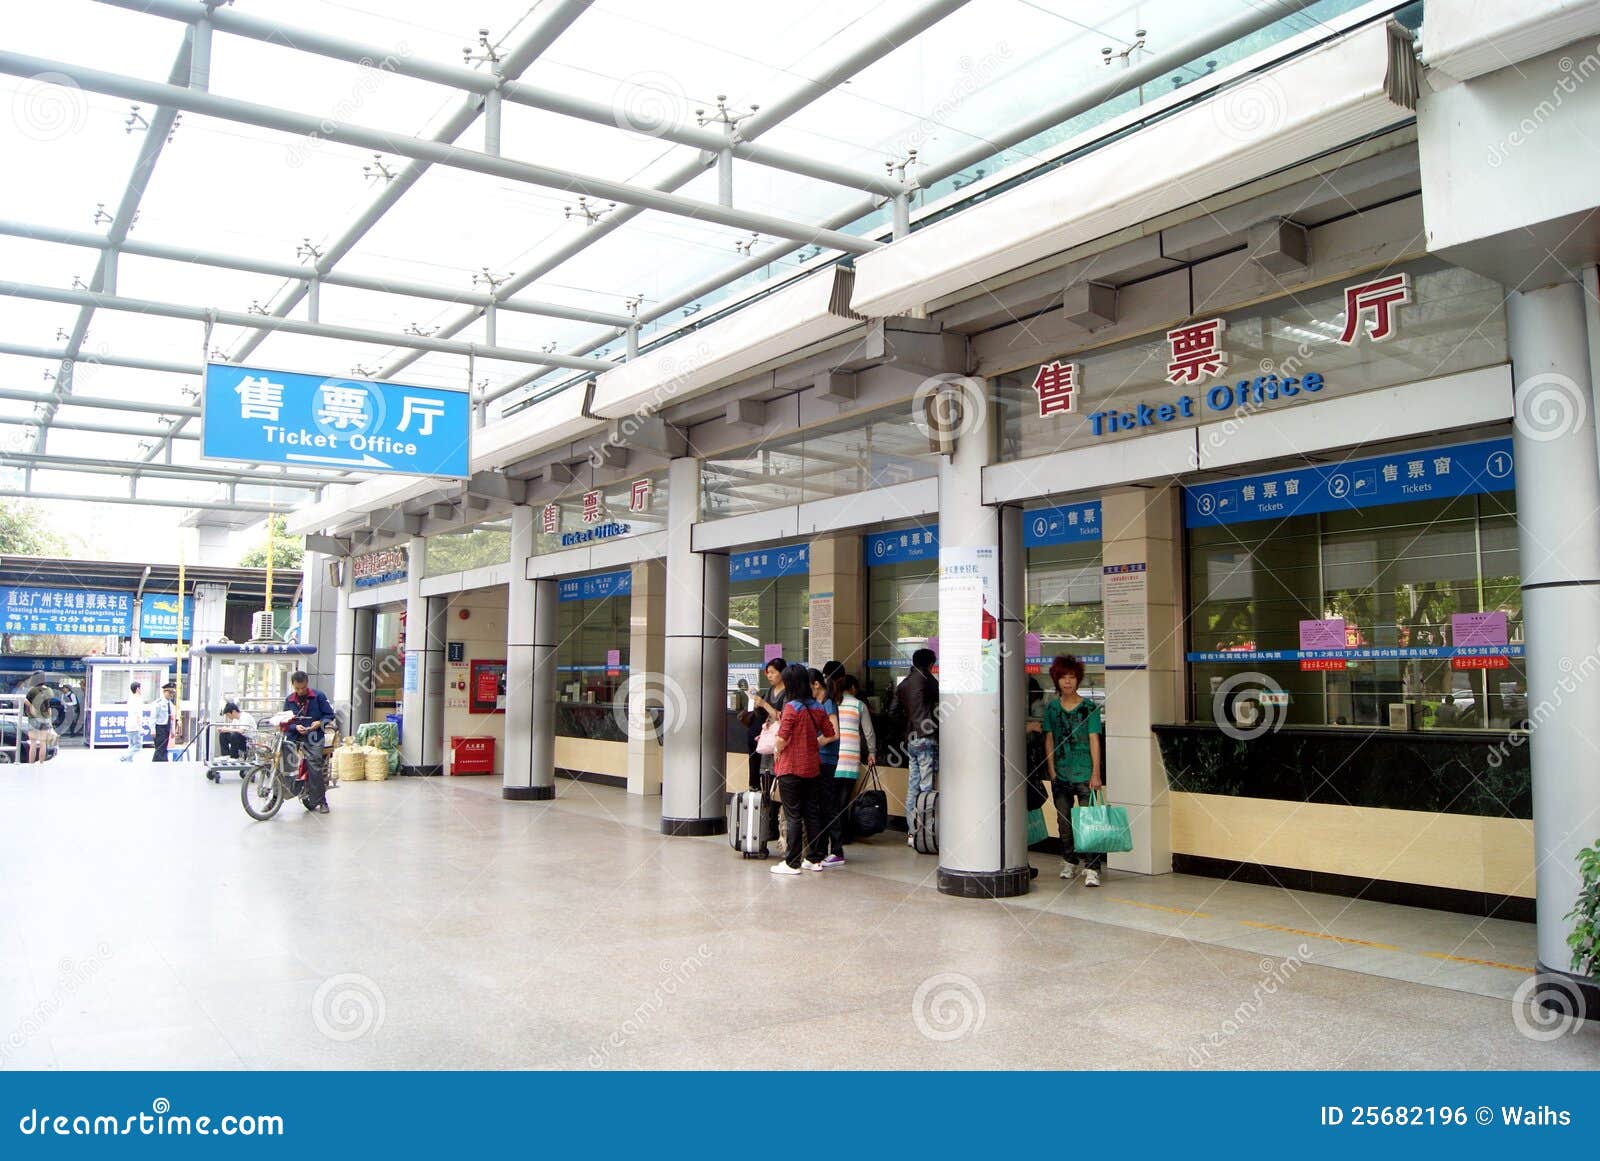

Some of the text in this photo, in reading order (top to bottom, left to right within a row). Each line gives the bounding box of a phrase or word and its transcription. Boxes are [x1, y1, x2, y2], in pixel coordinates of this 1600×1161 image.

[1032, 273, 1411, 418] 售票厅
[234, 375, 445, 436] 售票厅
[1087, 371, 1324, 436] Ticket Office
[263, 425, 417, 456] Ticket Office
[1382, 456, 1451, 483] 售票窗
[1242, 478, 1299, 501] 售票窗
[1402, 483, 1432, 494] Tickets
[543, 478, 652, 535] 售票厅
[1067, 508, 1102, 526] 售票
[1258, 502, 1284, 513] Tickets
[900, 532, 933, 547] 售票窗
[8, 590, 128, 610] 直达广州专线售票乘车区
